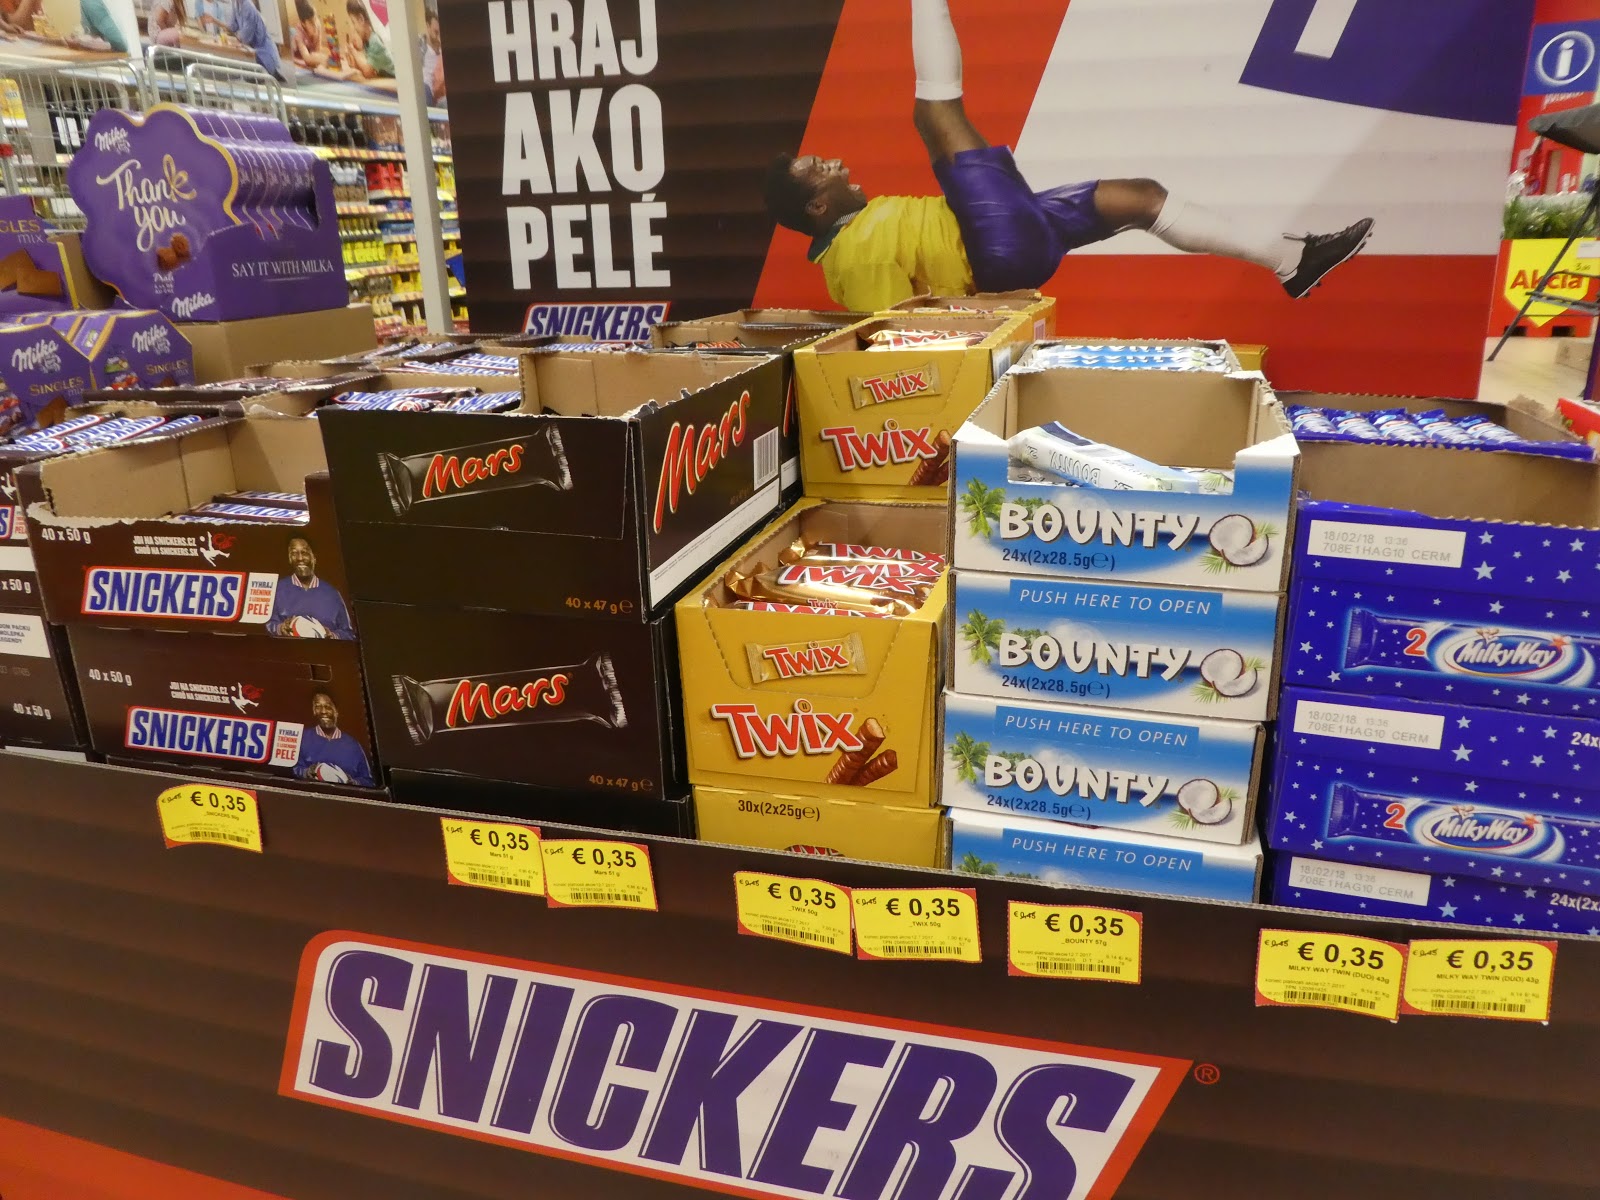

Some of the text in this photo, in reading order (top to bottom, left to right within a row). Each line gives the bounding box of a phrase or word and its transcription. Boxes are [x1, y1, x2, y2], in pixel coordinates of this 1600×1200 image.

[488, 0, 658, 82] HRAJ
[95, 127, 128, 152] Milka
[502, 84, 665, 195] AKO
[96, 154, 197, 211] Thank
[134, 205, 186, 252] you
[506, 193, 671, 290] PELÉ
[231, 259, 335, 278] SAY IT WITH MILKA
[172, 291, 215, 318] Milka
[528, 304, 664, 341] SNICKERS
[132, 324, 169, 353] Milka
[11, 339, 59, 373] Milka
[29, 376, 84, 397] SINGLES
[423, 444, 524, 499] Mars
[653, 390, 749, 534] Mars
[42, 528, 55, 541] 40
[66, 528, 81, 541] 50
[84, 531, 91, 544] g
[1000, 502, 1200, 551] BOUNTY
[1411, 549, 1451, 562] CERM
[10, 578, 22, 592] 50
[88, 570, 238, 618] SNICKERS
[565, 597, 581, 609] 40
[594, 600, 606, 611] 47
[1019, 588, 1211, 616] PUSH HERE TO OPEN
[1403, 628, 1427, 657] 2
[1000, 632, 1192, 682] BOUNTY
[89, 669, 101, 681] 40
[110, 671, 123, 683] 50
[13, 702, 24, 714] 40
[33, 705, 43, 717] 50
[446, 673, 569, 728] Mars
[132, 709, 269, 759] SNICKERS
[1005, 715, 1188, 747] PUSH HERE TO OPEN
[1392, 731, 1429, 744] CERM
[589, 774, 603, 784] 40
[616, 777, 628, 788] 47
[985, 755, 1170, 807] BOUNTY
[190, 791, 246, 812] € 0,35
[1383, 802, 1406, 830] 2
[470, 829, 529, 851] € 0,35
[1012, 837, 1192, 871] PUSH HERE TO OPEN
[572, 848, 637, 868] € 0,35
[767, 883, 836, 909] € 0,35
[1379, 886, 1414, 899] CERM
[886, 898, 960, 919] € 0,35
[1045, 913, 1124, 936] € 0,35
[1095, 939, 1107, 947] 57g
[1297, 942, 1384, 970] € 0,35
[1446, 949, 1534, 972] € 0,35
[1332, 968, 1351, 976] TWIN
[1376, 976, 1390, 984] 43g
[308, 952, 1137, 1200] SNICKERS
